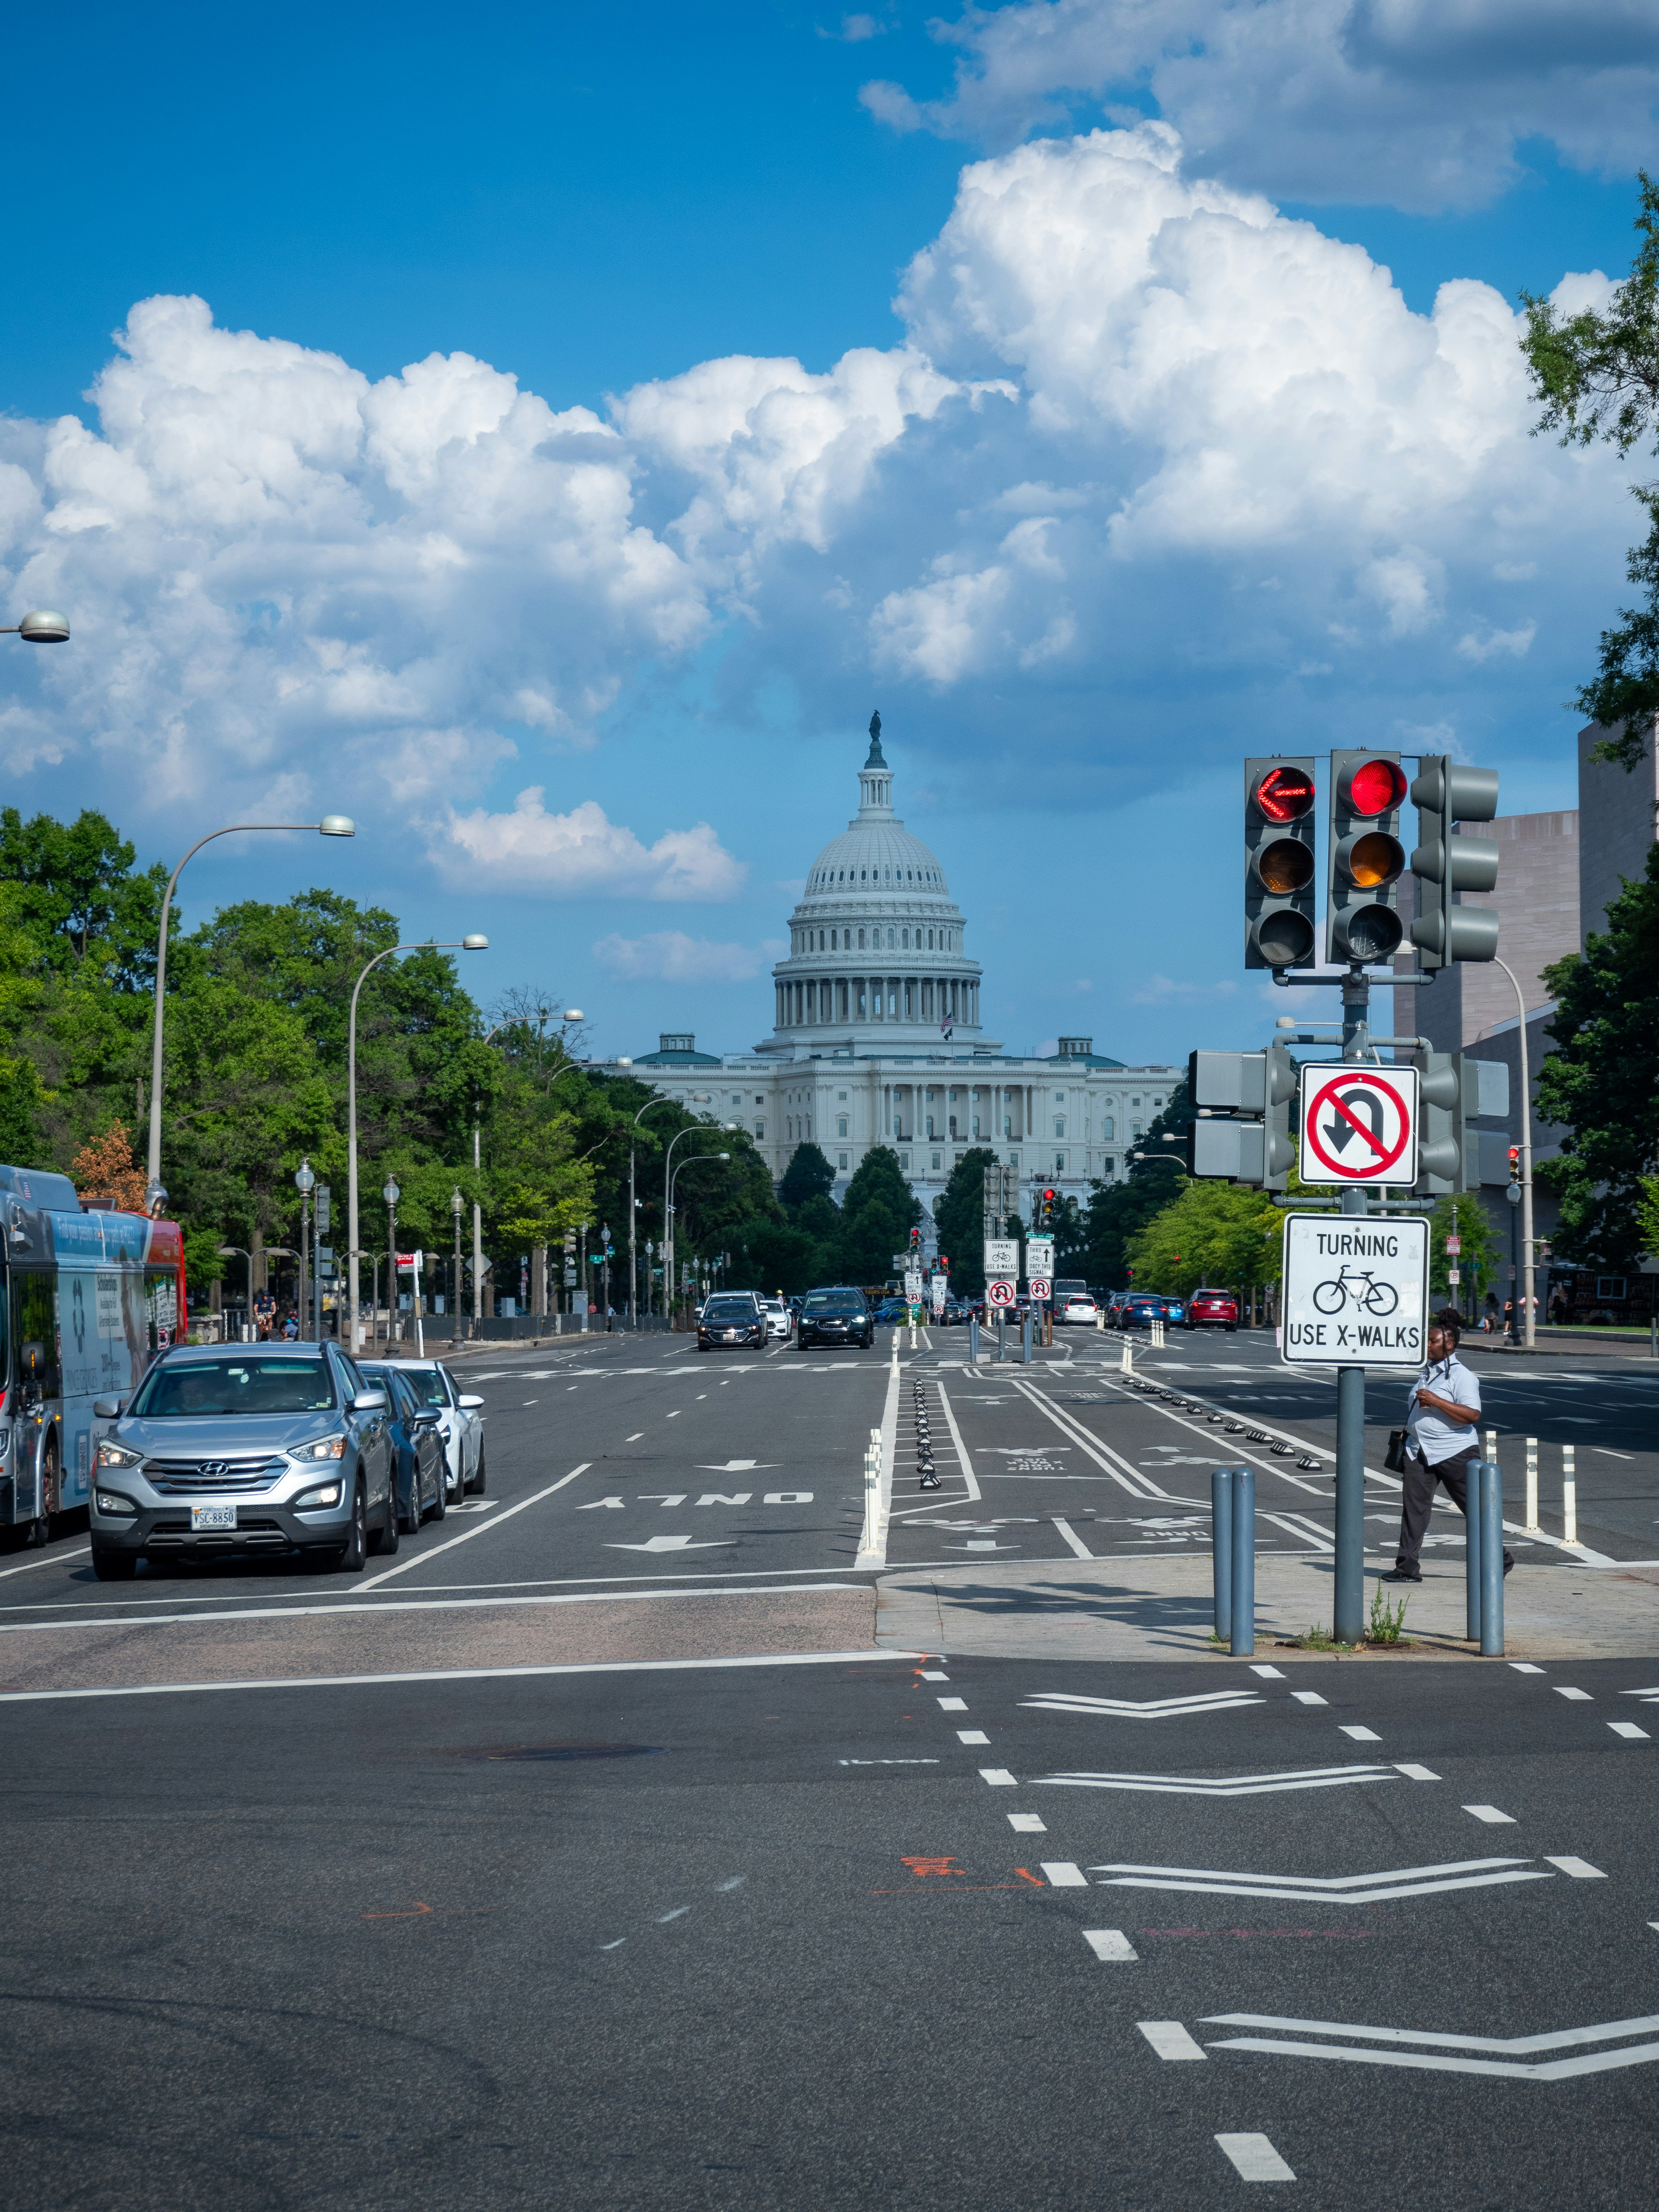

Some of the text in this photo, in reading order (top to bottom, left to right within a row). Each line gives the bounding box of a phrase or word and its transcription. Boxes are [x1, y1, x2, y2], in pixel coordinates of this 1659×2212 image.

[1317, 1234, 1398, 1257] TURNING
[1290, 1323, 1419, 1348] USE X-WALKS
[575, 1492, 814, 1509] ONLY
[194, 1512, 233, 1523] VSC-8850
